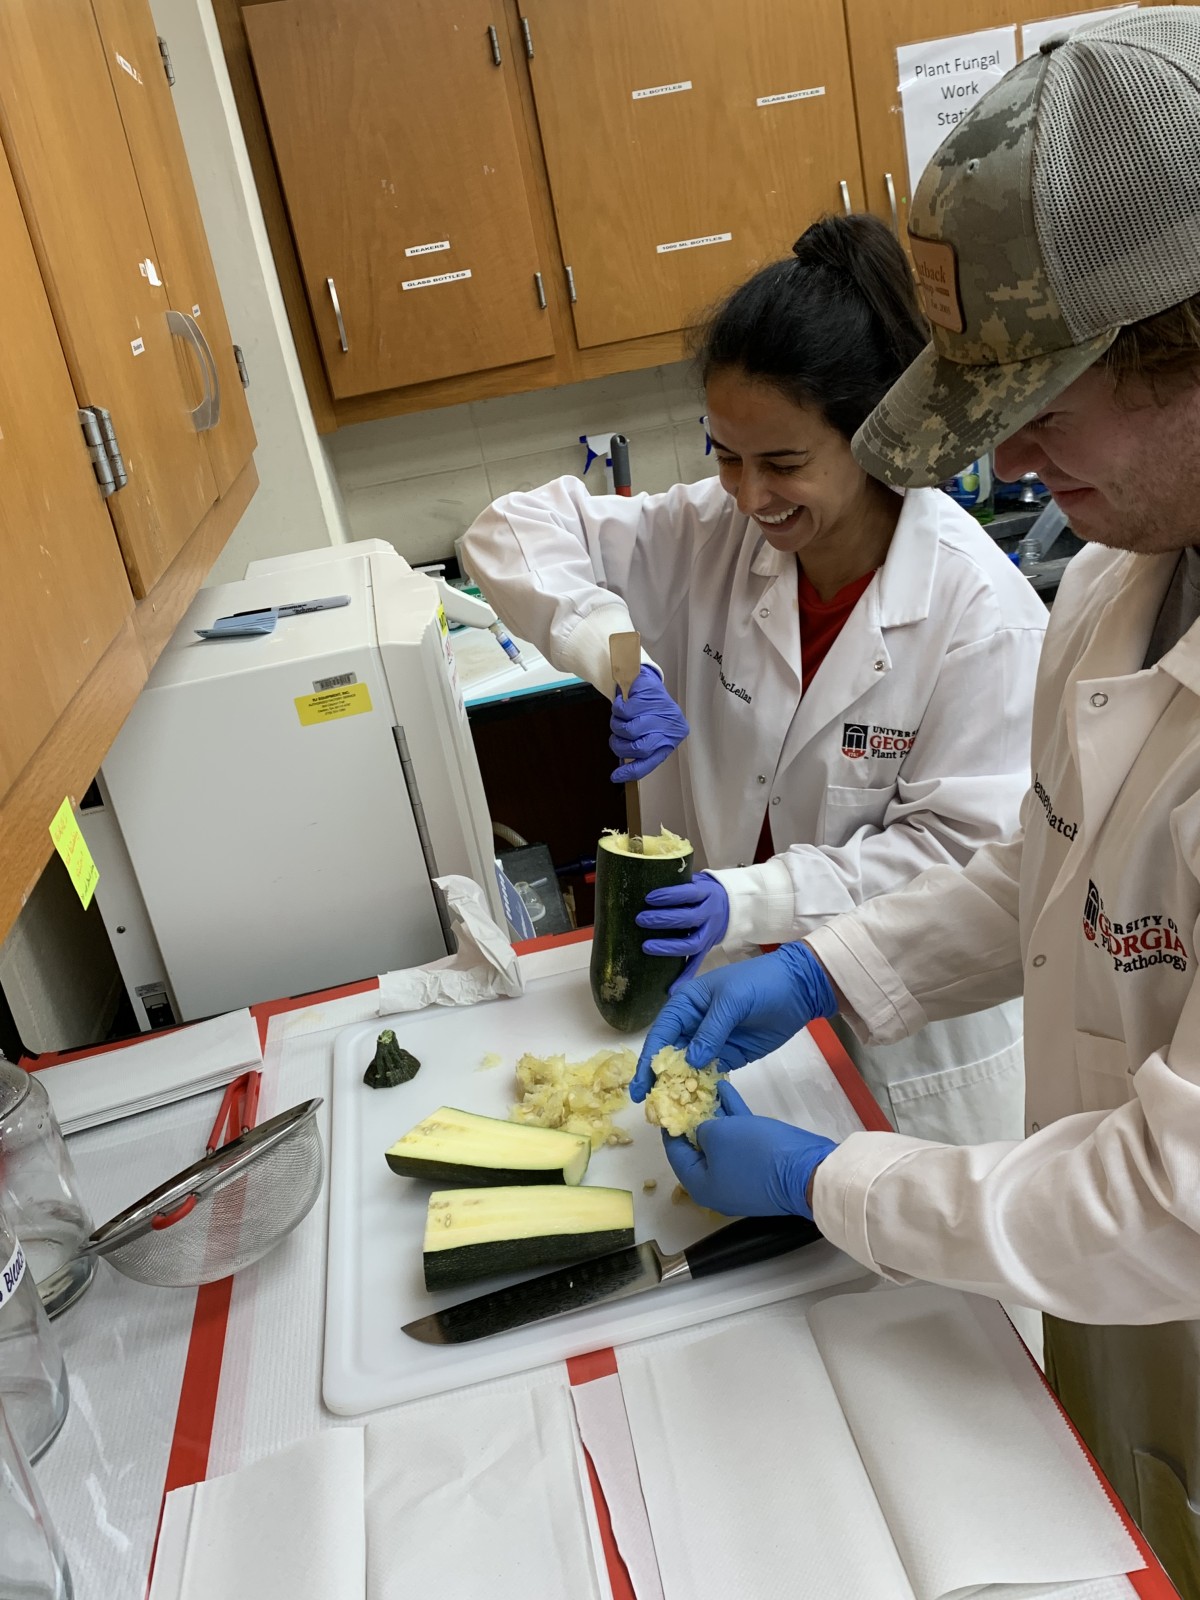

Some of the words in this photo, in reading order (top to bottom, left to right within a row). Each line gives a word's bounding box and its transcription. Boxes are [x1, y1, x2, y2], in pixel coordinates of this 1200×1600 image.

[914, 61, 951, 78] Plant
[954, 50, 1001, 72] Fungal
[649, 84, 683, 95] BOTTLES
[761, 95, 786, 104] GLASS
[787, 89, 821, 99] BOTTLES
[940, 80, 980, 100] Work
[690, 235, 723, 246] BOTTLES
[410, 243, 445, 254] BEAKERS
[406, 279, 432, 288] GLASS
[432, 272, 466, 283] BOTTLES
[703, 643, 713, 657] Dr.
[871, 749, 897, 759] Plant
[1113, 950, 1187, 973] Pathology
